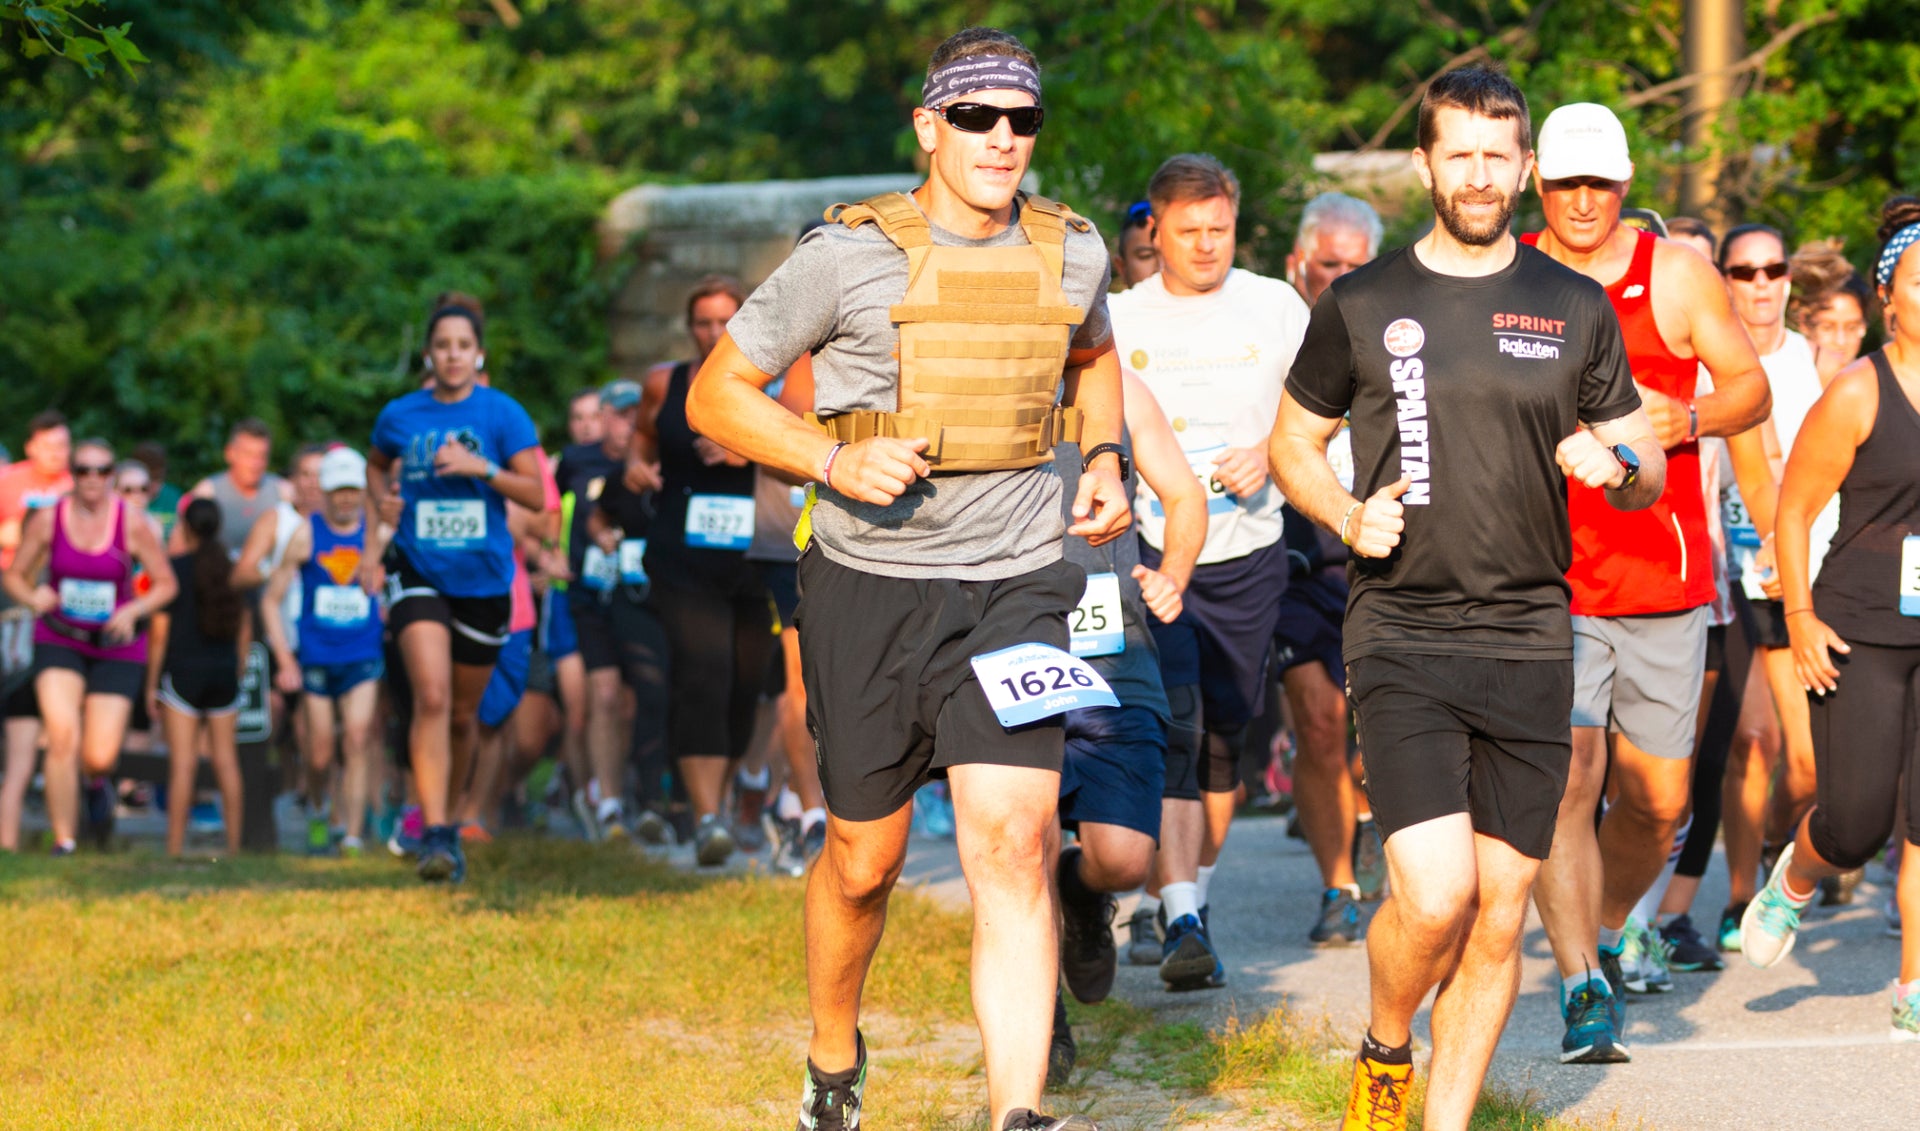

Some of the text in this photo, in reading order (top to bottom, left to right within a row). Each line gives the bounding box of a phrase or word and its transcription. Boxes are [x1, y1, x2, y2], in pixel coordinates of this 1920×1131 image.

[1492, 313, 1566, 335] SPRINT
[1499, 338, 1559, 359] Rakuten
[1389, 357, 1430, 505] SPARTAN
[423, 516, 479, 536] 3509
[698, 512, 743, 531] 1827
[1000, 666, 1094, 701] 1626
[1042, 694, 1078, 711] John
